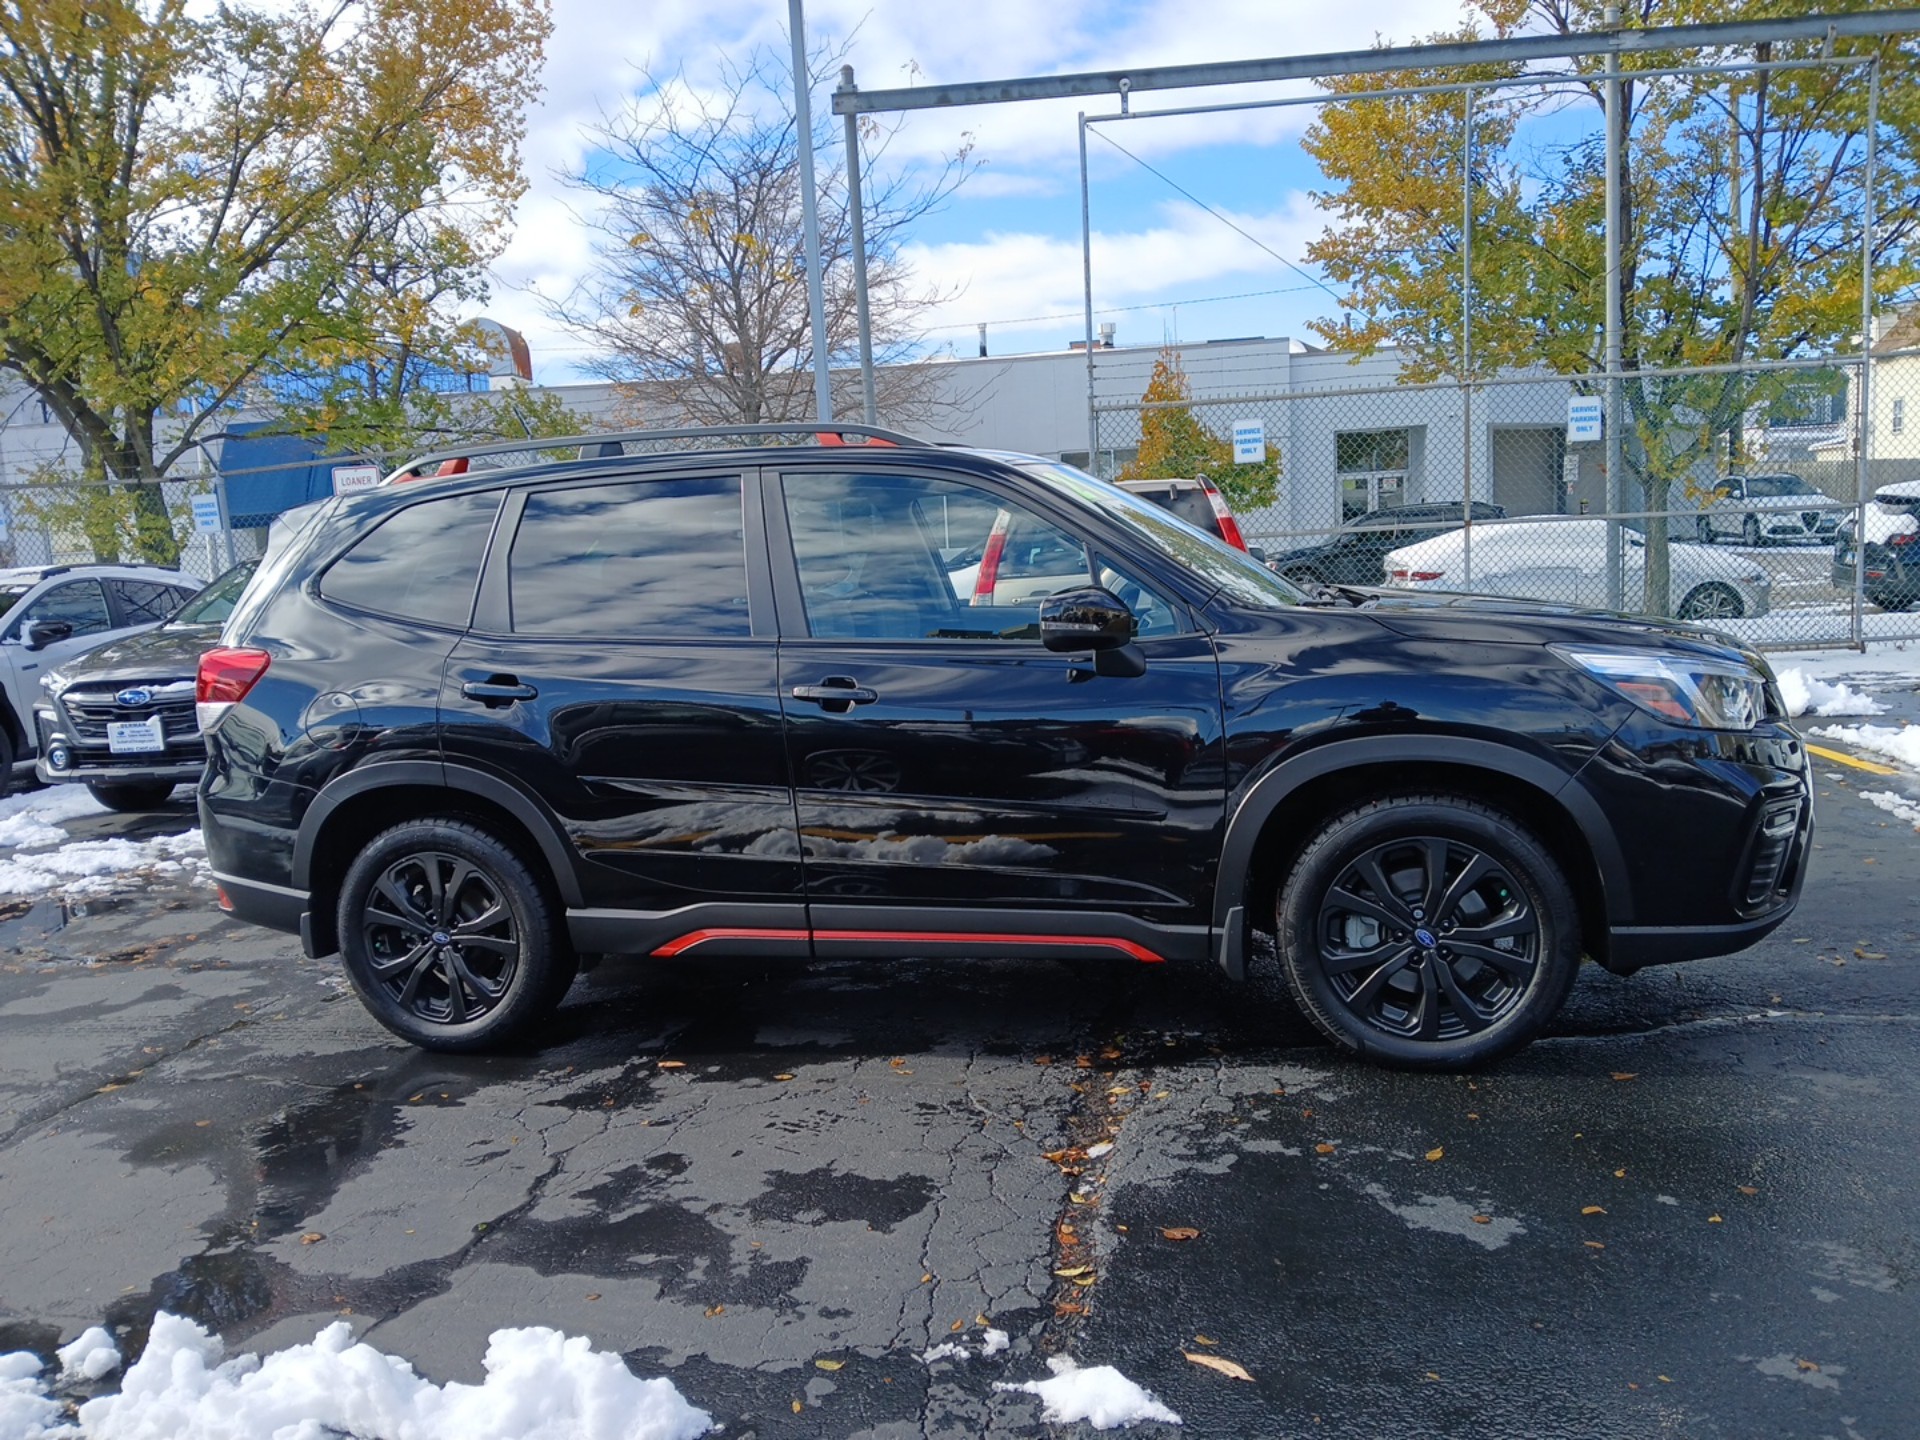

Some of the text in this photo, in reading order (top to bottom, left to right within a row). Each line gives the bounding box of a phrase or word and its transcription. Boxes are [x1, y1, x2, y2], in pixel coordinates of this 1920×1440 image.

[1571, 405, 1598, 413] SERVICE
[1570, 415, 1600, 423] PARKING
[1235, 437, 1263, 445] PARKING
[340, 475, 373, 486] LOANER
